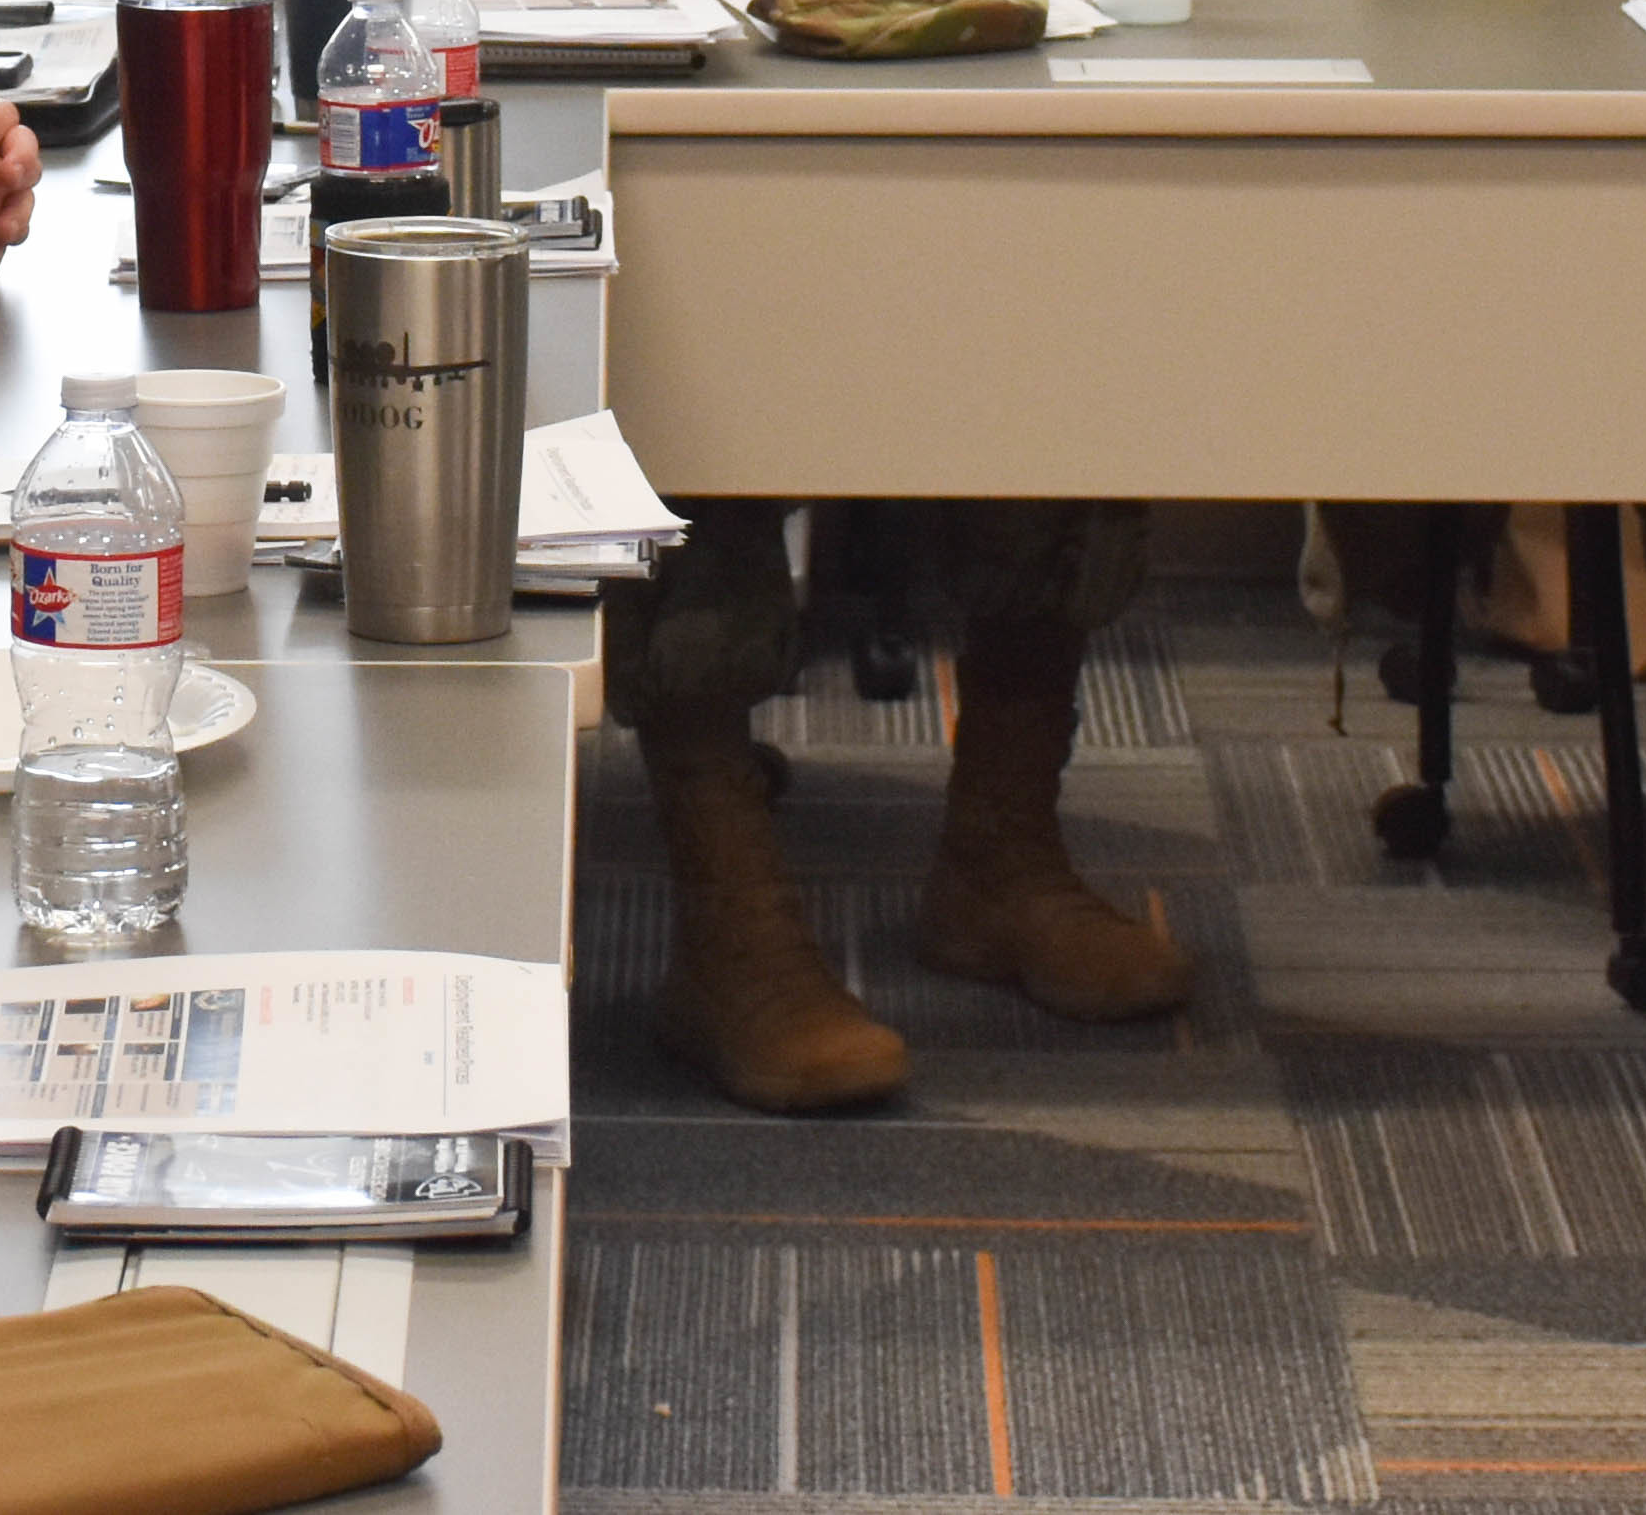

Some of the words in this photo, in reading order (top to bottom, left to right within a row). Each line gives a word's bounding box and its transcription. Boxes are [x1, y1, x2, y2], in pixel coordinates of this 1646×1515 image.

[90, 563, 121, 574] Born
[126, 563, 143, 573] for
[92, 576, 140, 588] Quality
